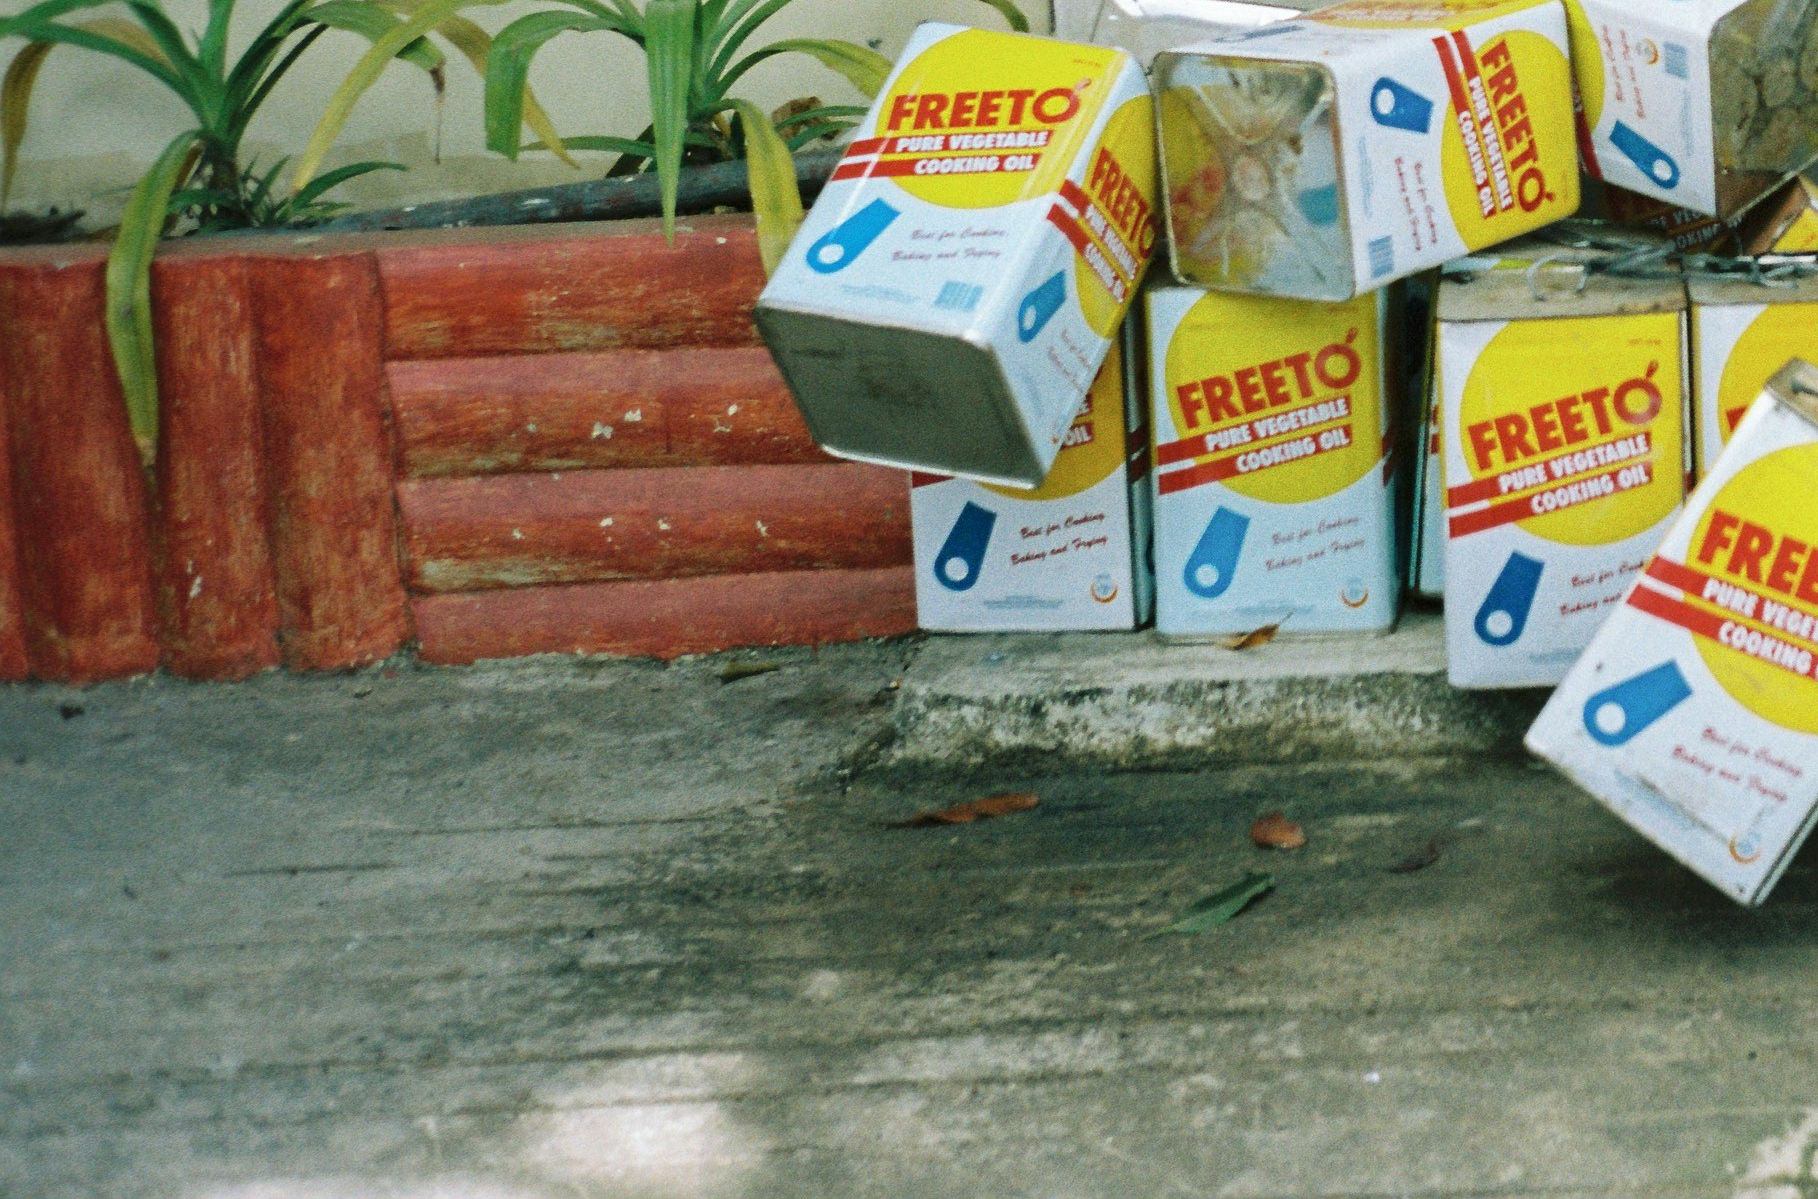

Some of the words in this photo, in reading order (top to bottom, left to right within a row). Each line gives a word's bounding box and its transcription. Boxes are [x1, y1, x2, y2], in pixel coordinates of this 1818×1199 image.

[888, 77, 1092, 130] FREETO
[1481, 39, 1555, 213] FREETO
[896, 136, 944, 152] PURE
[949, 131, 1049, 150] VEGETABLE
[914, 156, 1000, 174] COOKING
[1003, 154, 1034, 170] OIL
[1458, 111, 1488, 186] COOKING
[1478, 186, 1496, 216] OIL
[1468, 76, 1491, 119] PURE
[1482, 121, 1513, 209] VEGETABLE
[1090, 147, 1160, 259] FREETO
[1177, 327, 1361, 430] FREETO
[1205, 425, 1251, 453] PURE
[1255, 399, 1349, 438] VEGETABLE
[1468, 359, 1662, 472] FREETO
[1236, 437, 1316, 473] COOKING
[1320, 429, 1350, 450] OIL
[1499, 466, 1546, 495] PURE
[1551, 435, 1649, 477] VEGETABLE
[1531, 474, 1614, 515] COOKING
[1618, 466, 1649, 489] OIL
[1010, 552, 1047, 565] Baking
[1050, 545, 1069, 556] and
[1072, 535, 1108, 550] Frying
[1020, 526, 1042, 539] Best
[1046, 522, 1060, 536] for
[1064, 512, 1105, 528] Cooking
[1702, 577, 1757, 619] PURE
[1718, 621, 1812, 678] COOKING
